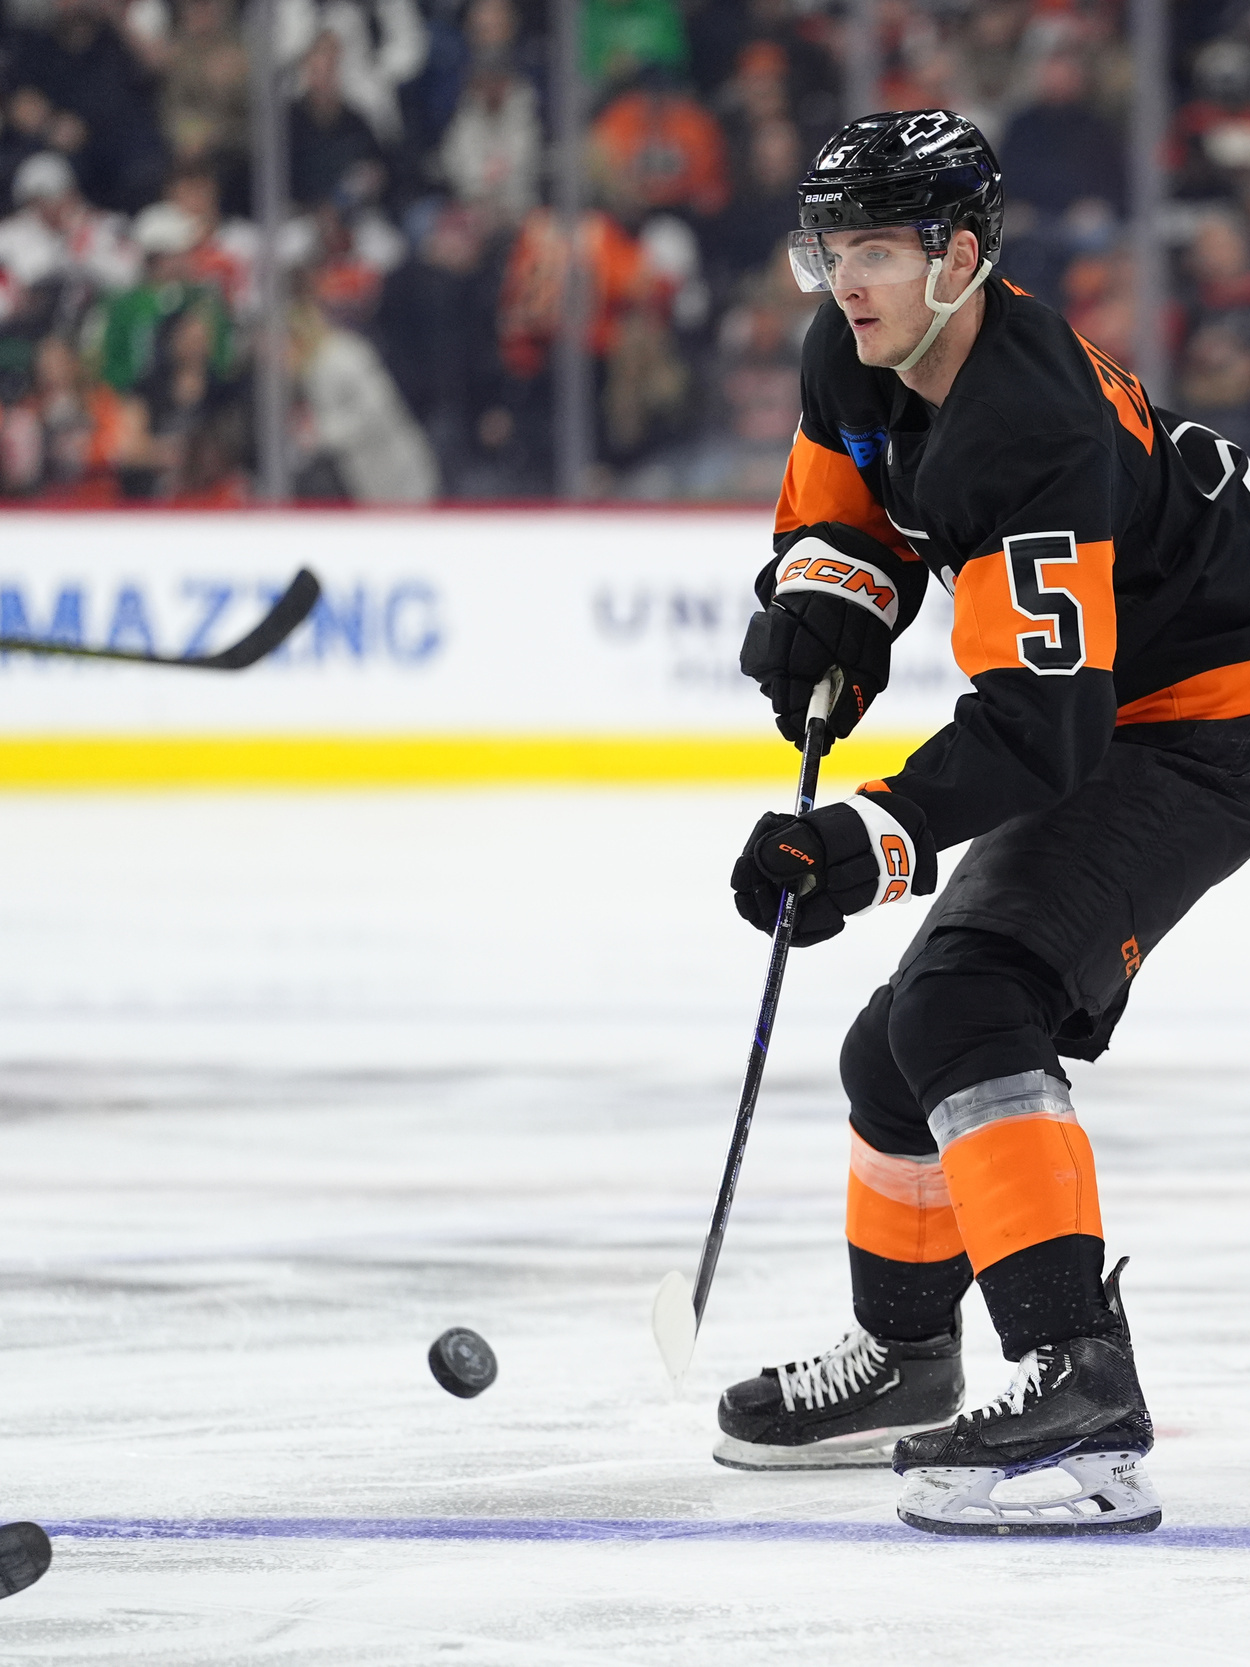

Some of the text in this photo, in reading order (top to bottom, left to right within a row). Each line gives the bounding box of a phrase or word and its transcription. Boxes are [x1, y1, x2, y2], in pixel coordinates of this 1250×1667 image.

[826, 145, 857, 169] 5
[804, 192, 843, 203] BAUER
[778, 557, 896, 612] CCM
[1002, 530, 1087, 676] 5
[0, 577, 443, 667] MAZNG
[852, 684, 864, 721] CCM
[778, 843, 815, 866] CCM
